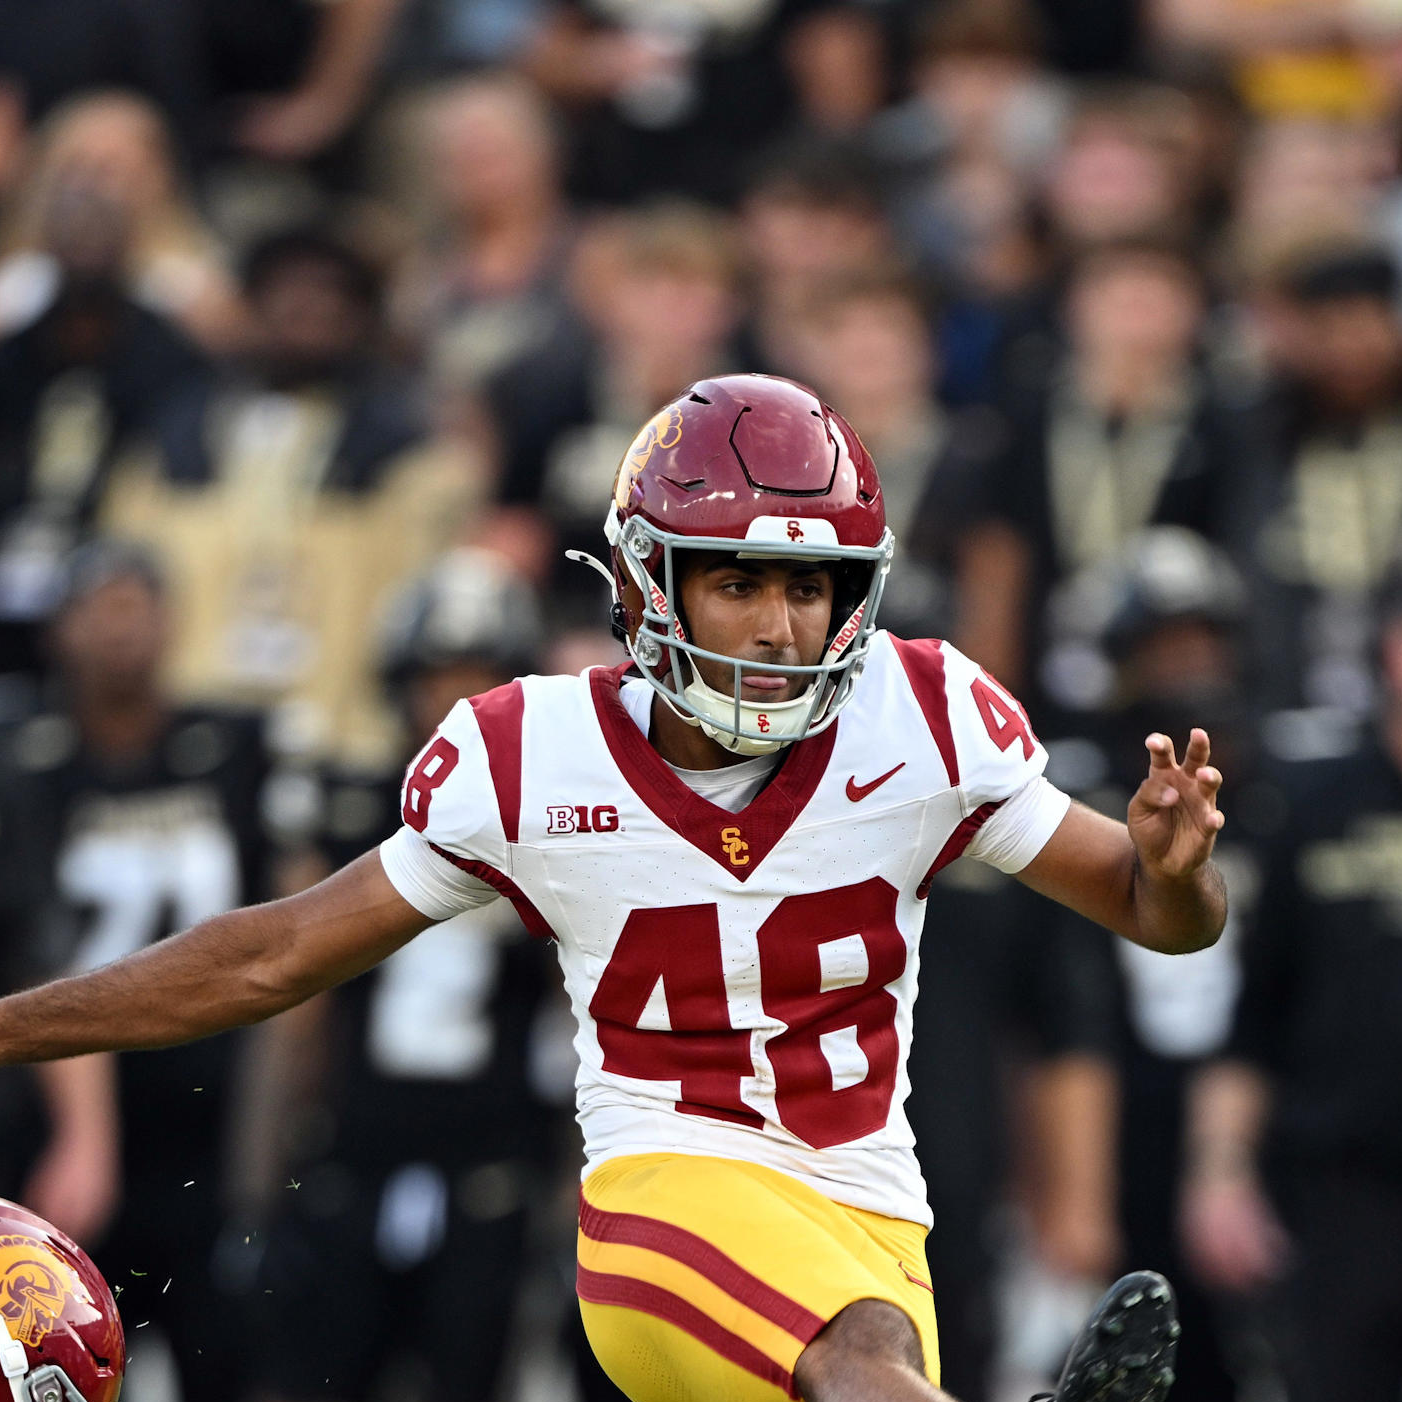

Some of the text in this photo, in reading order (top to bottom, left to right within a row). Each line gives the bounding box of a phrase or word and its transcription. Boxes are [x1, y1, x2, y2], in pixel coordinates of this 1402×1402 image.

[757, 713, 771, 734] SC
[969, 665, 1040, 762] 4
[402, 727, 460, 834] 8
[721, 826, 750, 866] SC
[590, 875, 907, 1150] 48
